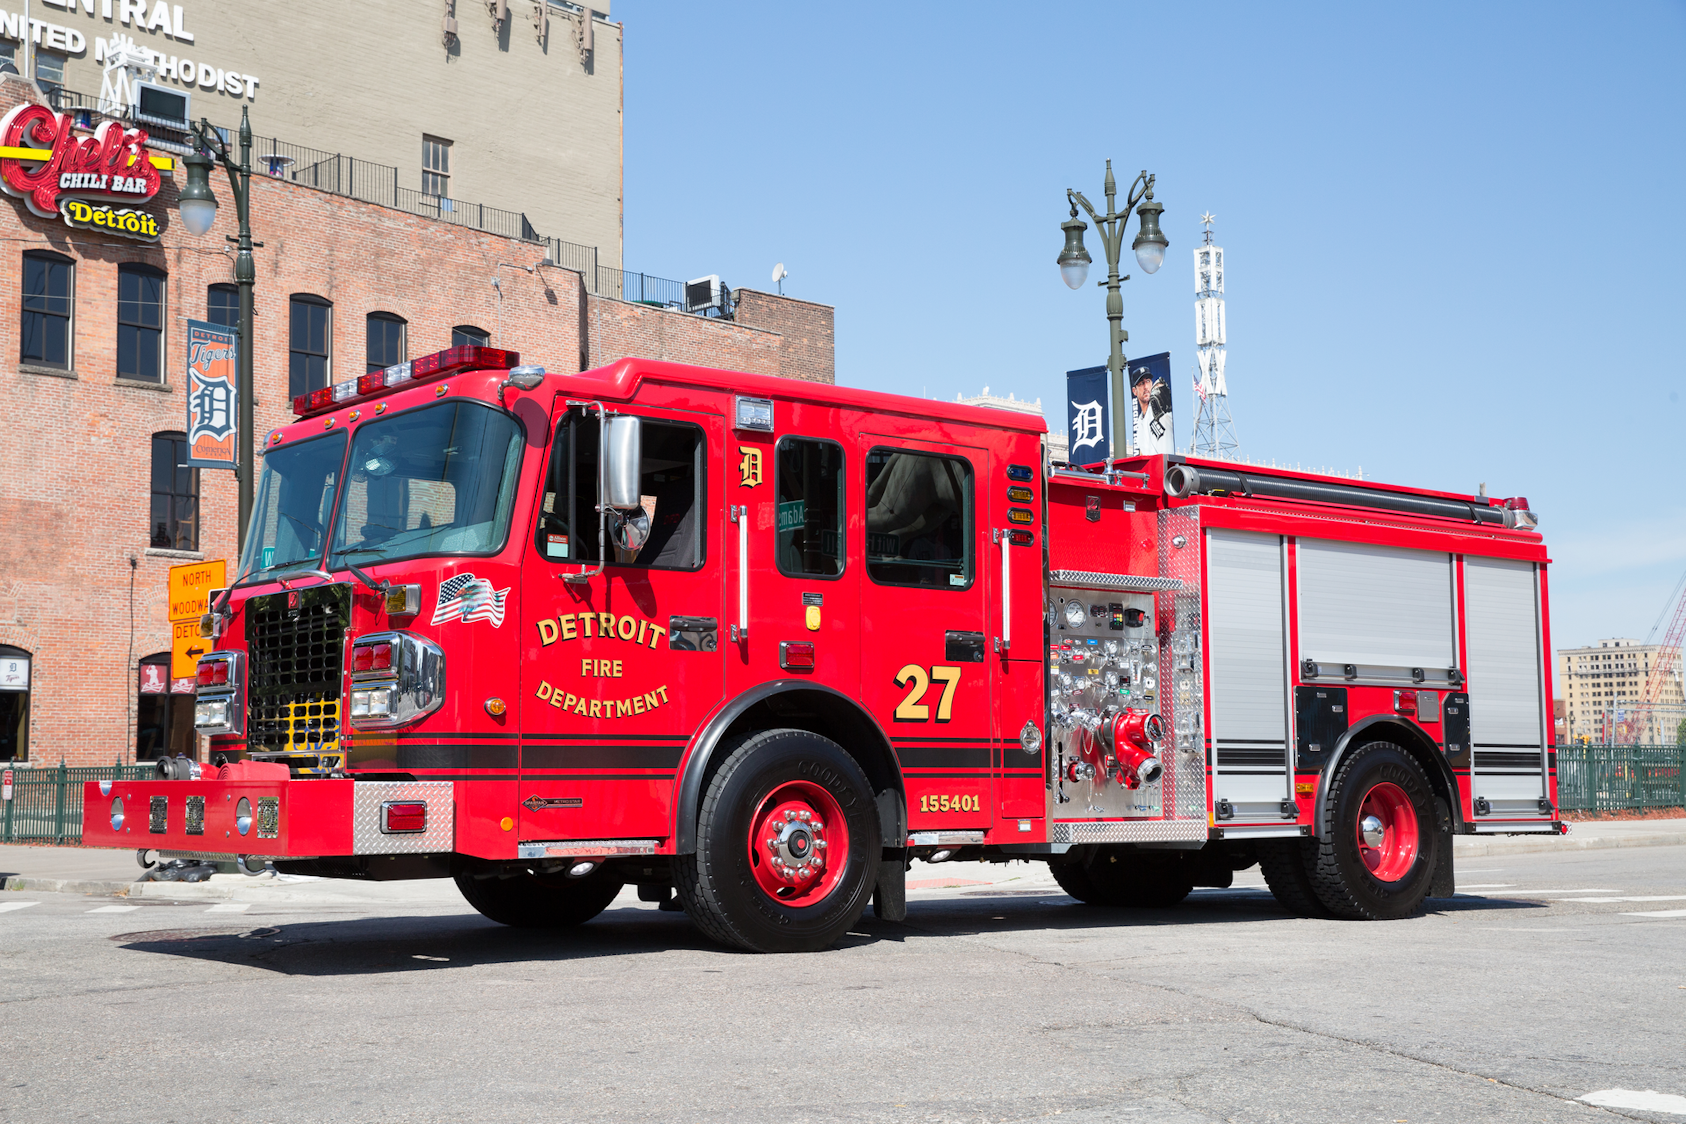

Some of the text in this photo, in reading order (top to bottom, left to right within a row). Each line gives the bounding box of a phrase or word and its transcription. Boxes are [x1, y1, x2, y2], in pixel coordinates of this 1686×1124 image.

[0, 9, 259, 98] NITED MTHODIST
[59, 172, 148, 194] CHILI BAR
[69, 201, 158, 237] Detroit
[189, 340, 236, 371] Tigers
[183, 570, 211, 587] NORTH
[172, 599, 209, 616] WOODWA
[176, 624, 200, 639] DETO
[536, 612, 667, 650] DETROIT
[581, 658, 623, 678] FIRE
[535, 680, 669, 719] DEPARTMENT
[893, 664, 962, 723] 27
[920, 794, 981, 813] 155401
